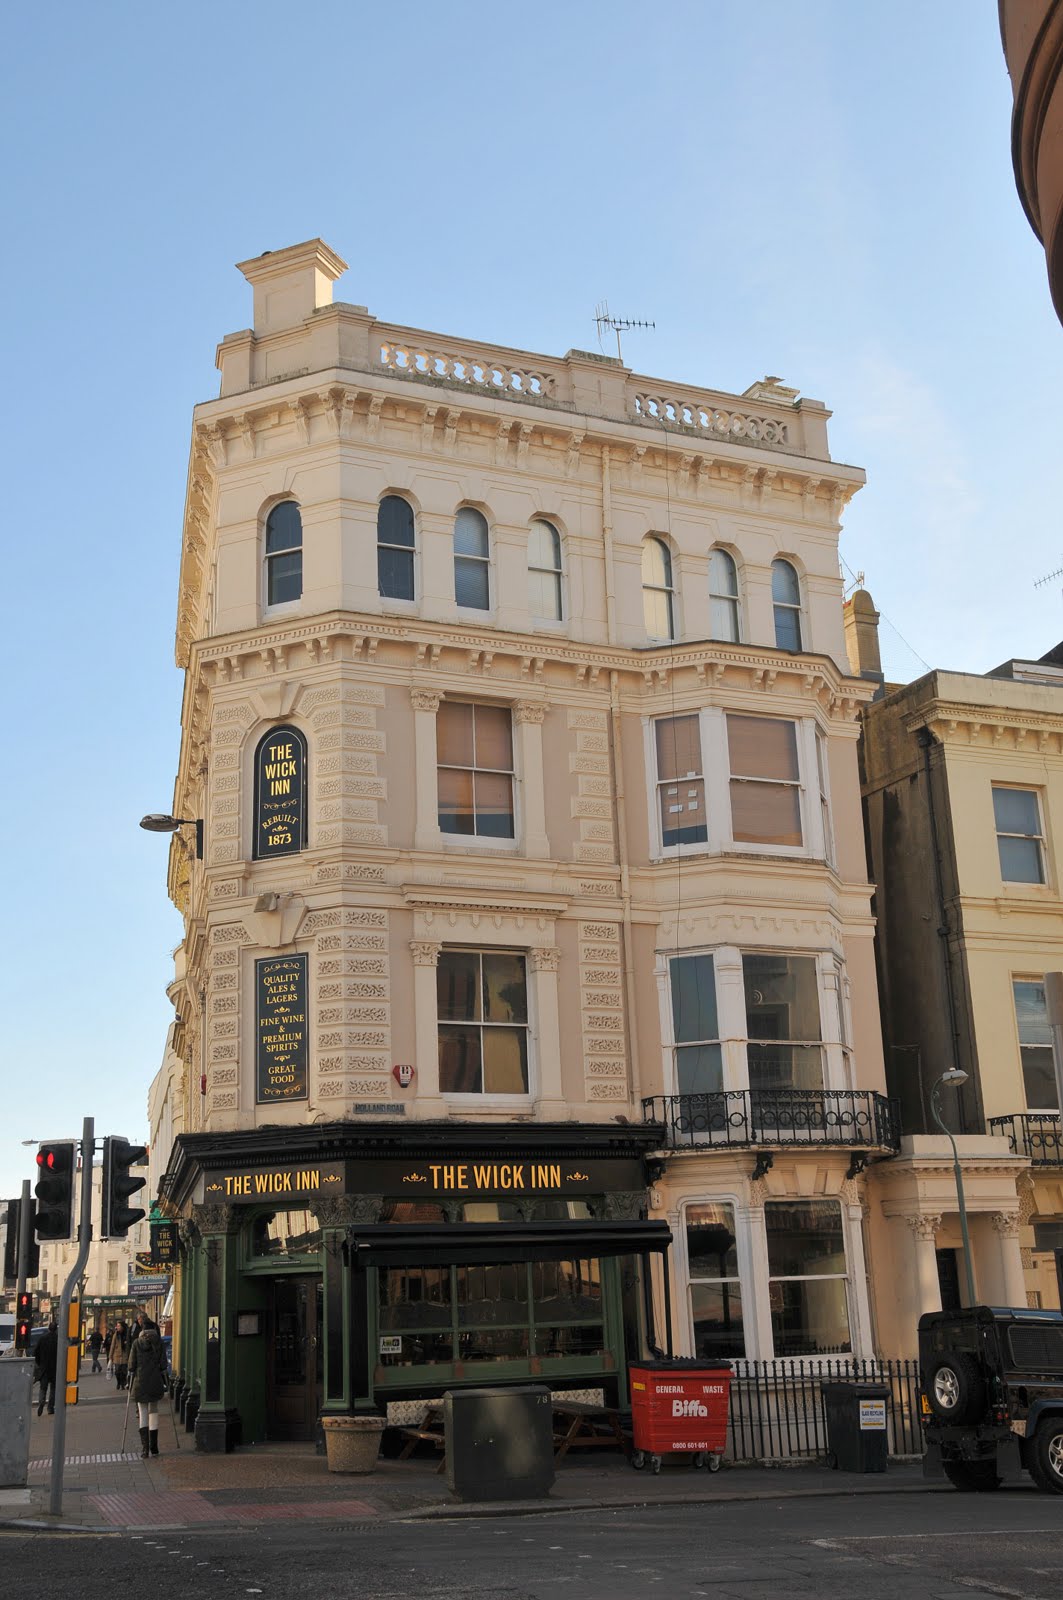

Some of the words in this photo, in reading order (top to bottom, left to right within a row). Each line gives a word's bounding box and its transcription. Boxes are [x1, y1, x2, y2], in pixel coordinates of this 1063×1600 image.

[269, 744, 293, 762] THE
[265, 760, 297, 780] WICK
[270, 779, 290, 796] INN
[262, 814, 299, 830] REBUILT
[267, 833, 292, 846] 1873
[263, 973, 300, 987] QUALITY
[268, 985, 288, 994] ALES
[289, 984, 296, 992] &
[266, 994, 298, 1005] LAGERS
[260, 1016, 280, 1027] FINE
[282, 1014, 305, 1024] WINE
[262, 1032, 302, 1044] PREMIUM
[266, 1042, 299, 1053] SPIRITS
[268, 1064, 296, 1075] GREAT
[270, 1074, 295, 1085] FOOD
[224, 1175, 252, 1195] THE
[255, 1172, 292, 1194] WICK
[296, 1170, 320, 1191] INN
[430, 1165, 469, 1189] THE
[473, 1165, 525, 1189] WICK
[531, 1165, 561, 1188] INN
[655, 1385, 685, 1394] GENERAL
[702, 1385, 724, 1394] WASTE
[672, 1400, 708, 1417] Biffa
